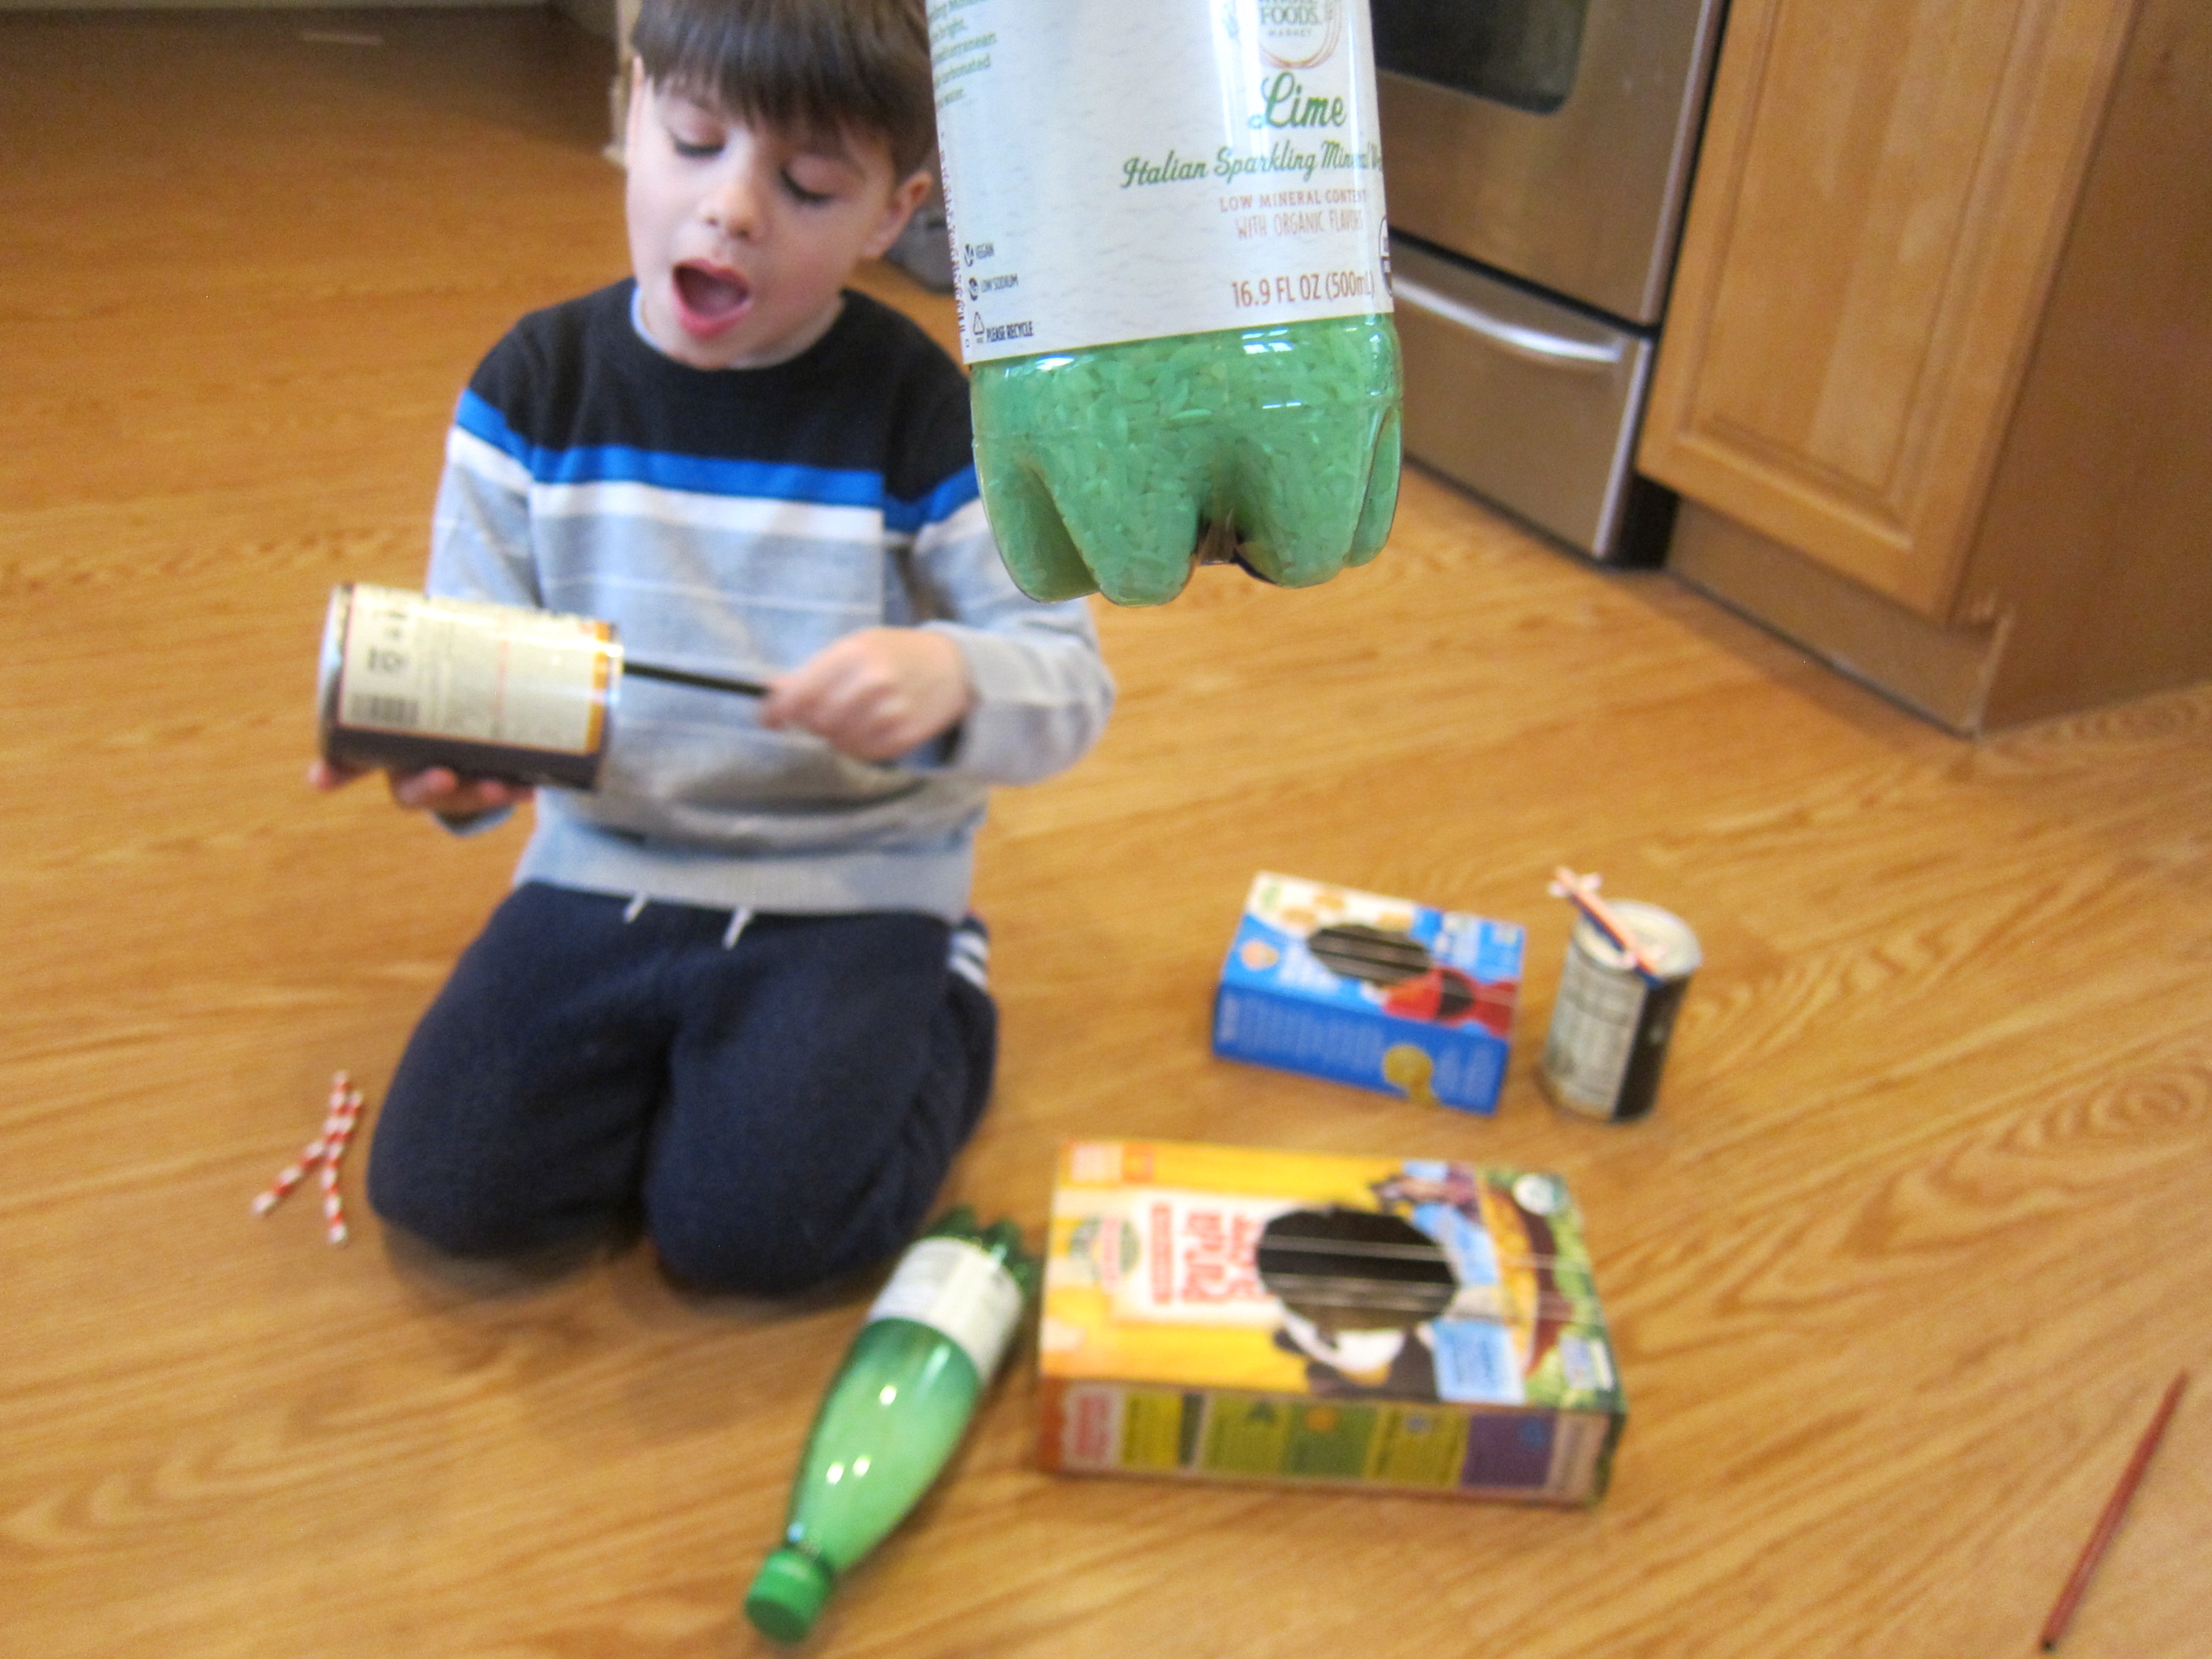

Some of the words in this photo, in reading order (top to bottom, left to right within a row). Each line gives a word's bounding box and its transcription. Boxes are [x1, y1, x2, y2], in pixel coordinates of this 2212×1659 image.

[1248, 71, 1346, 130] Lime
[1121, 149, 1207, 189] Italian
[1214, 140, 1317, 183] Sparkling
[1219, 195, 1253, 212] LOW
[1260, 189, 1322, 207] MINERAL
[1236, 214, 1267, 239] WITH
[1274, 210, 1324, 236] ORGANIC
[1232, 278, 1271, 308] 16.9
[1276, 275, 1295, 303] FL
[1299, 273, 1322, 302] OZ
[1325, 269, 1375, 302] (500mL)
[986, 325, 1006, 342] PLEASE
[1006, 320, 1034, 340] RECYCLE
